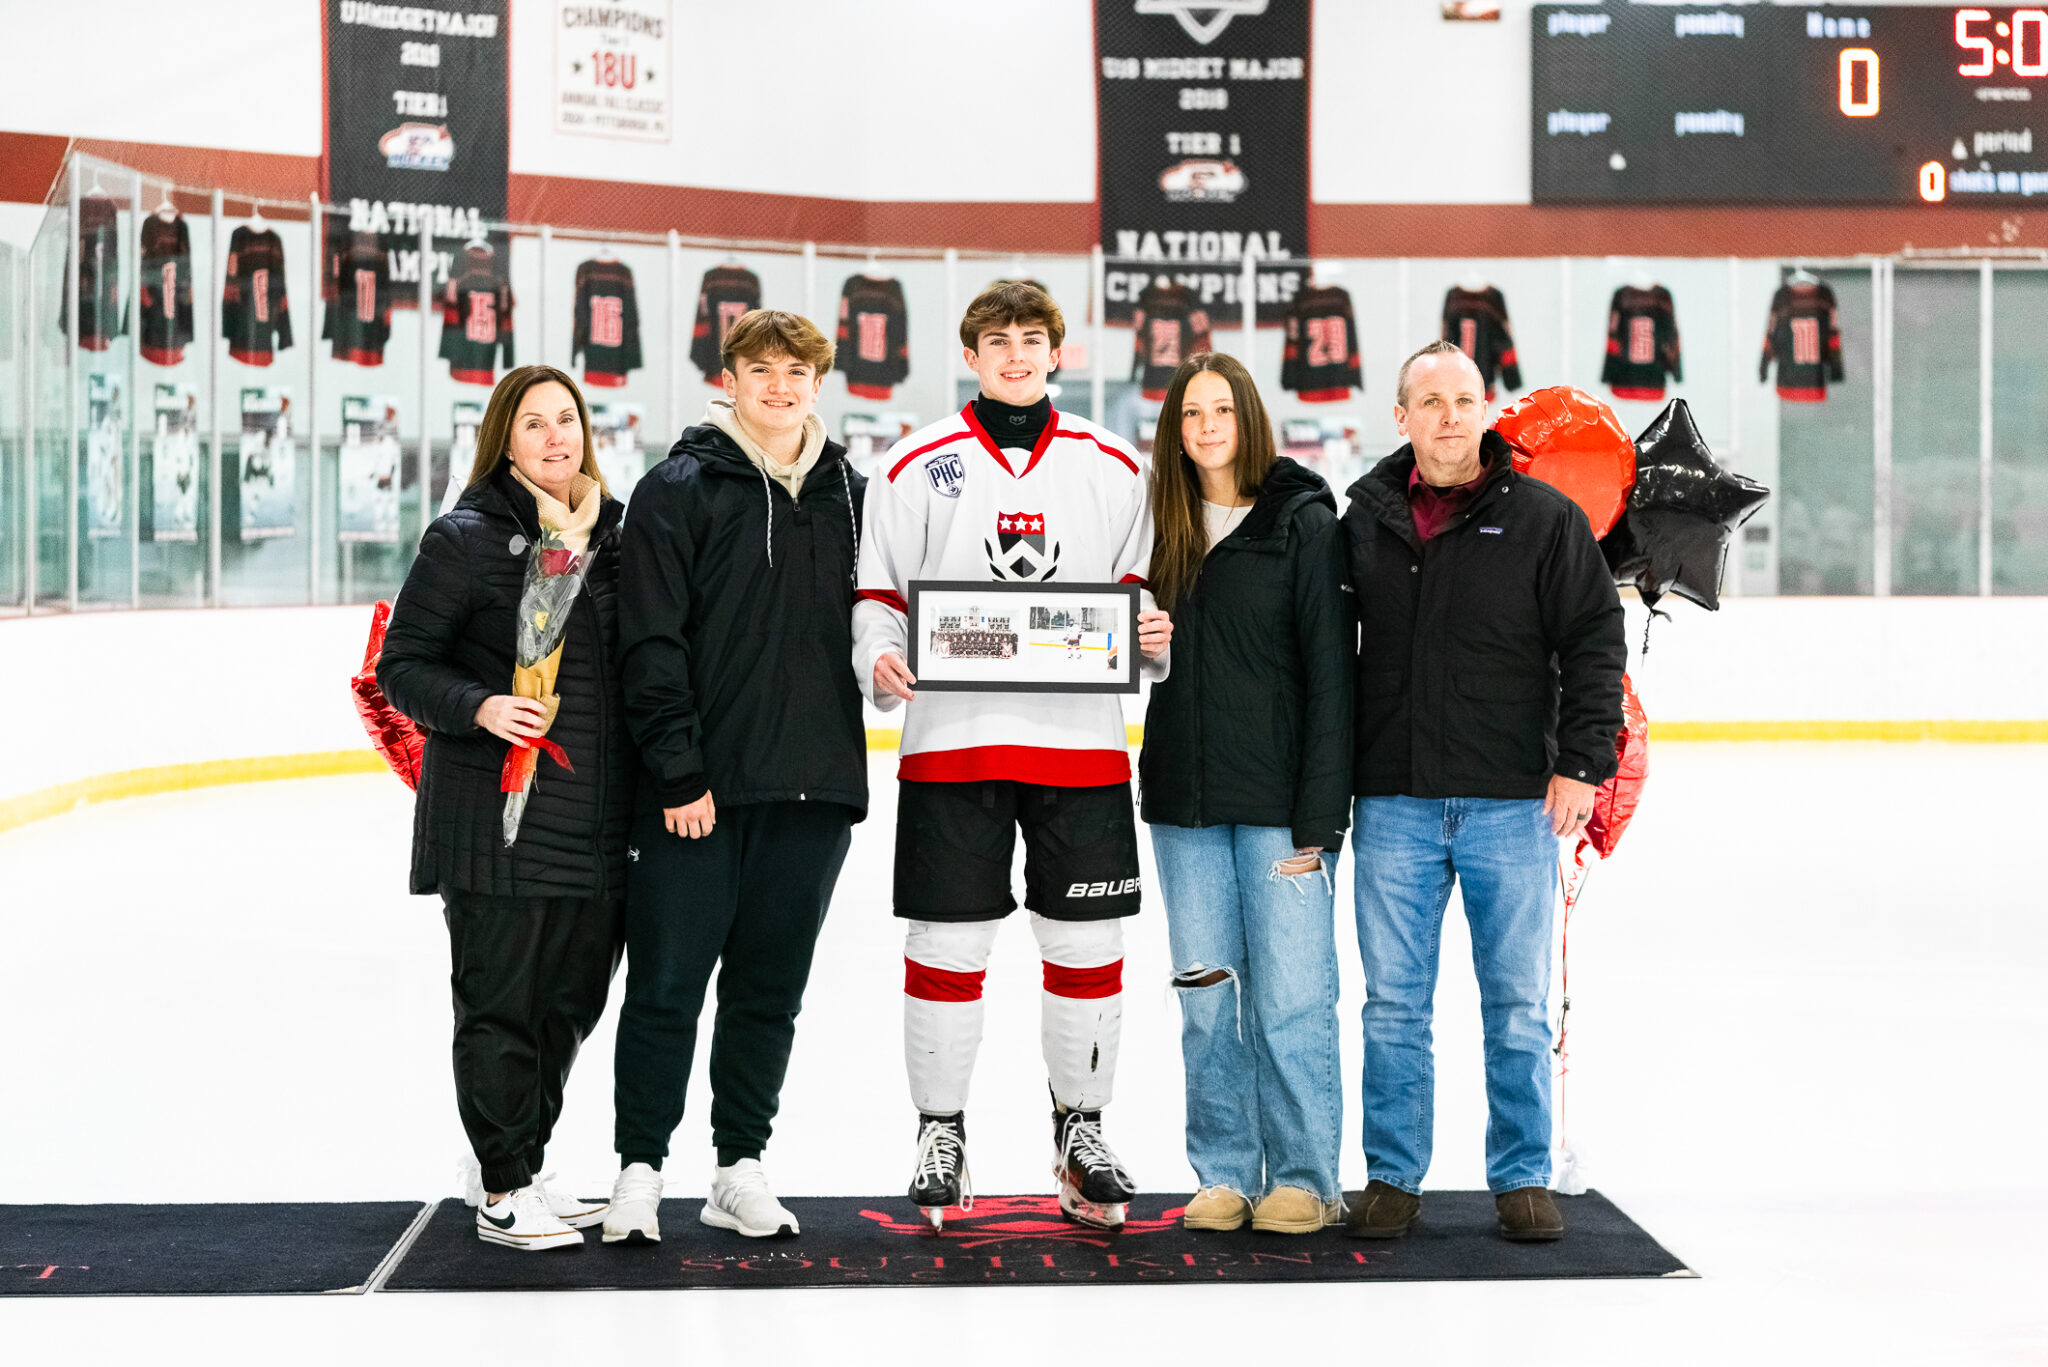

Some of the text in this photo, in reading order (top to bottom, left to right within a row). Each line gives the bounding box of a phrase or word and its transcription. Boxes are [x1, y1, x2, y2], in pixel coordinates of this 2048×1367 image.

[563, 7, 664, 38] CHAMPIONS
[592, 51, 636, 90] 18U
[1839, 47, 1880, 117] 0
[1117, 230, 1291, 261] NATIONAL
[1106, 271, 1300, 303] CPINS
[929, 459, 963, 488] PHC
[1065, 877, 1141, 898] BAUER
[681, 1250, 1394, 1272] SOUTH KENT
